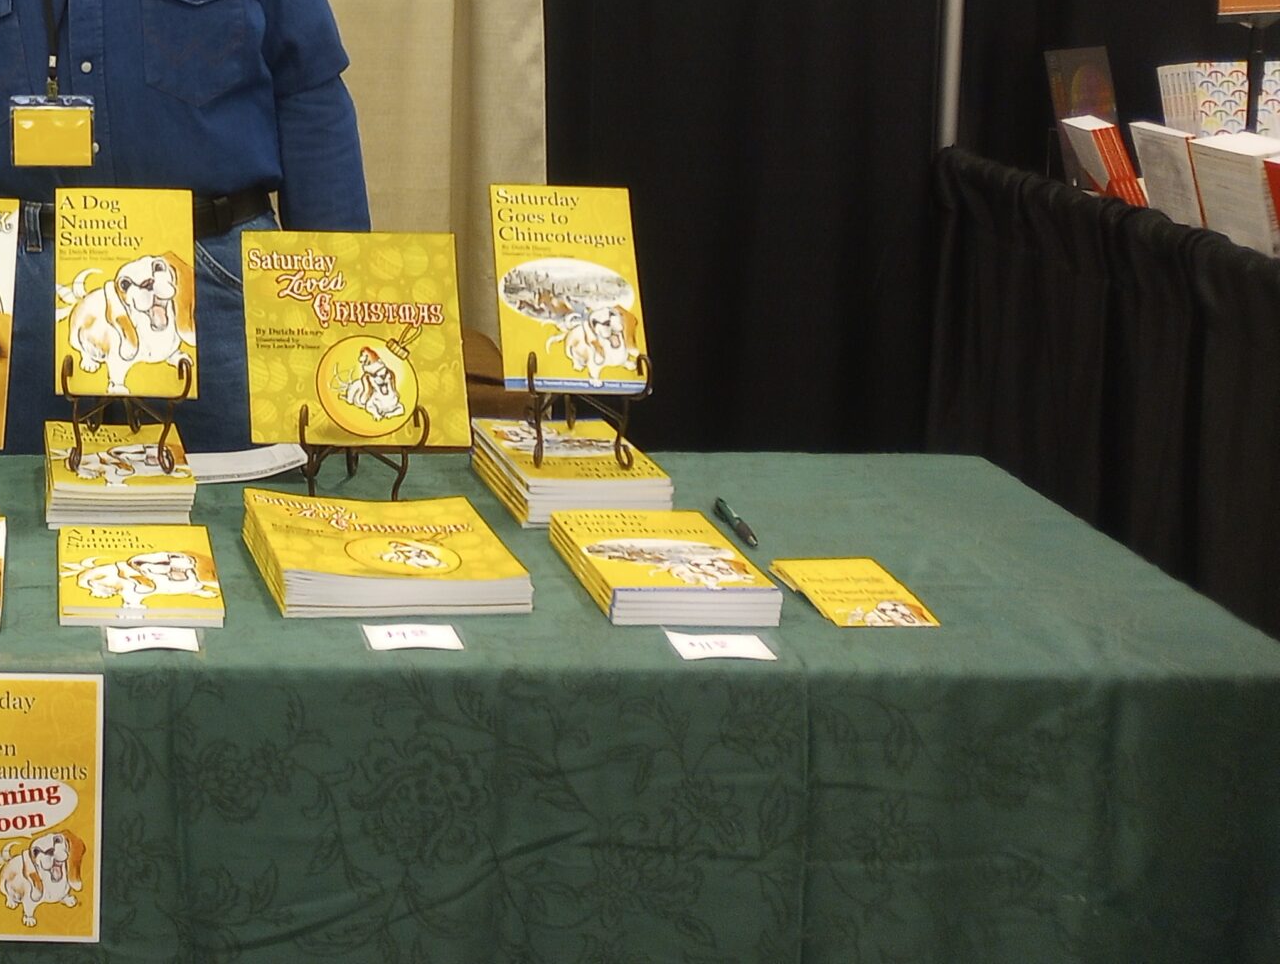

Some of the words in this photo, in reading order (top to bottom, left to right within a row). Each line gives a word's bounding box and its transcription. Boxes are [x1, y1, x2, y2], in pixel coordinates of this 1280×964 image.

[59, 196, 74, 210] A
[83, 196, 120, 213] Dog
[496, 190, 579, 210] Saturday
[60, 215, 127, 230] Named
[497, 208, 545, 224] Goes
[551, 212, 569, 224] to
[59, 231, 143, 250] Saturday
[498, 227, 627, 248] Chincoteague
[248, 249, 336, 276] Saturday
[277, 271, 346, 300] Loved
[256, 328, 265, 336] By
[297, 328, 324, 336] Henry
